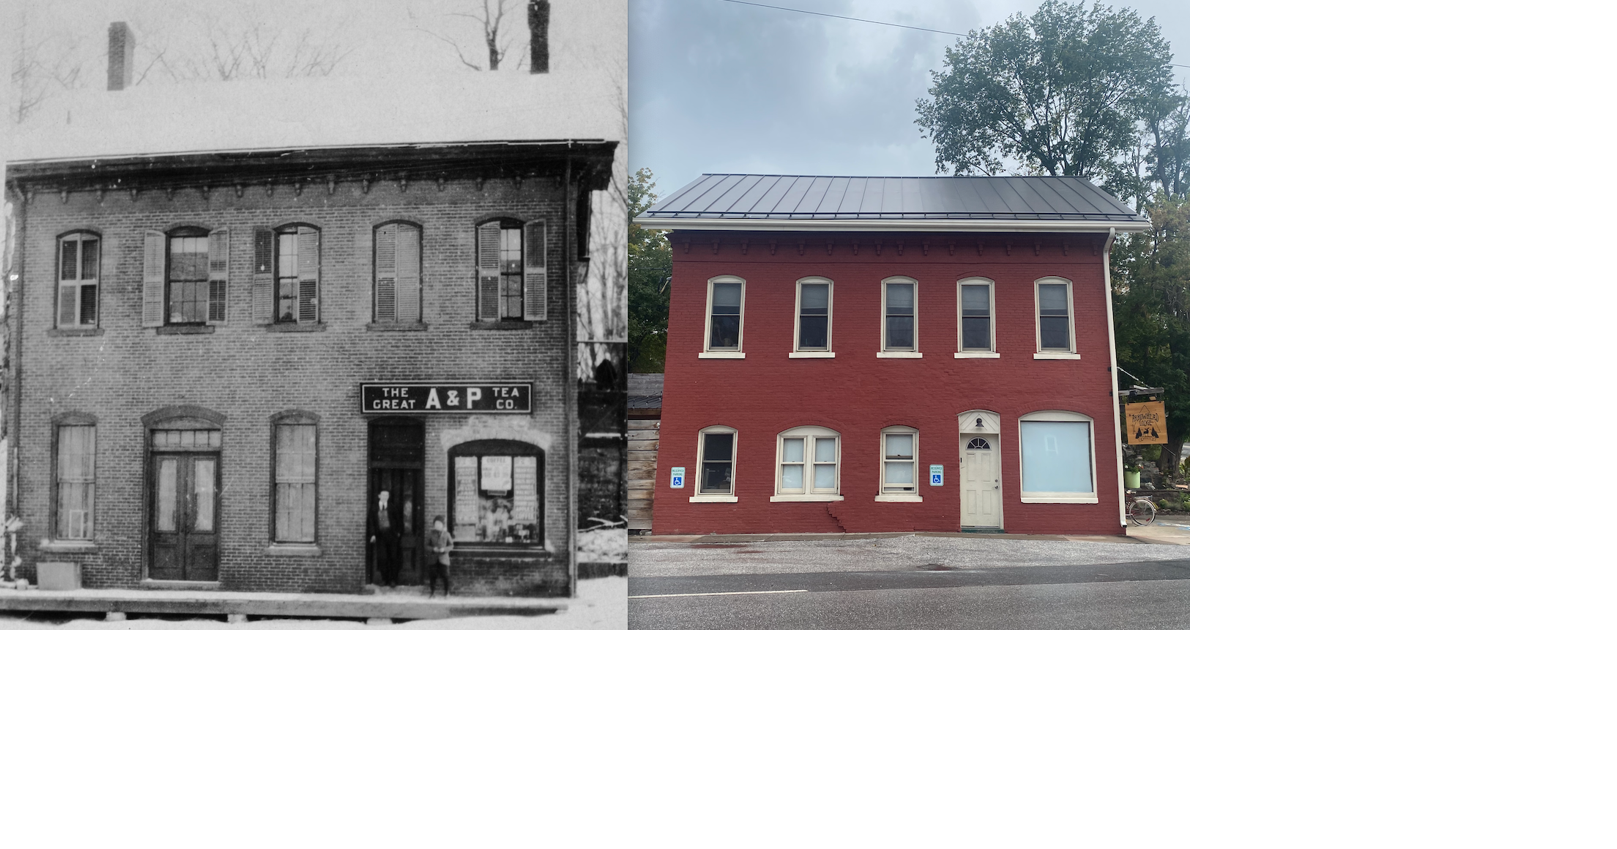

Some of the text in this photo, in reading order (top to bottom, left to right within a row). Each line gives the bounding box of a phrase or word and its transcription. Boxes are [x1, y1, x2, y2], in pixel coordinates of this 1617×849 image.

[382, 387, 409, 397] THE
[492, 387, 519, 397] TEA
[373, 399, 416, 409] GREAT
[496, 399, 518, 409] CO.
